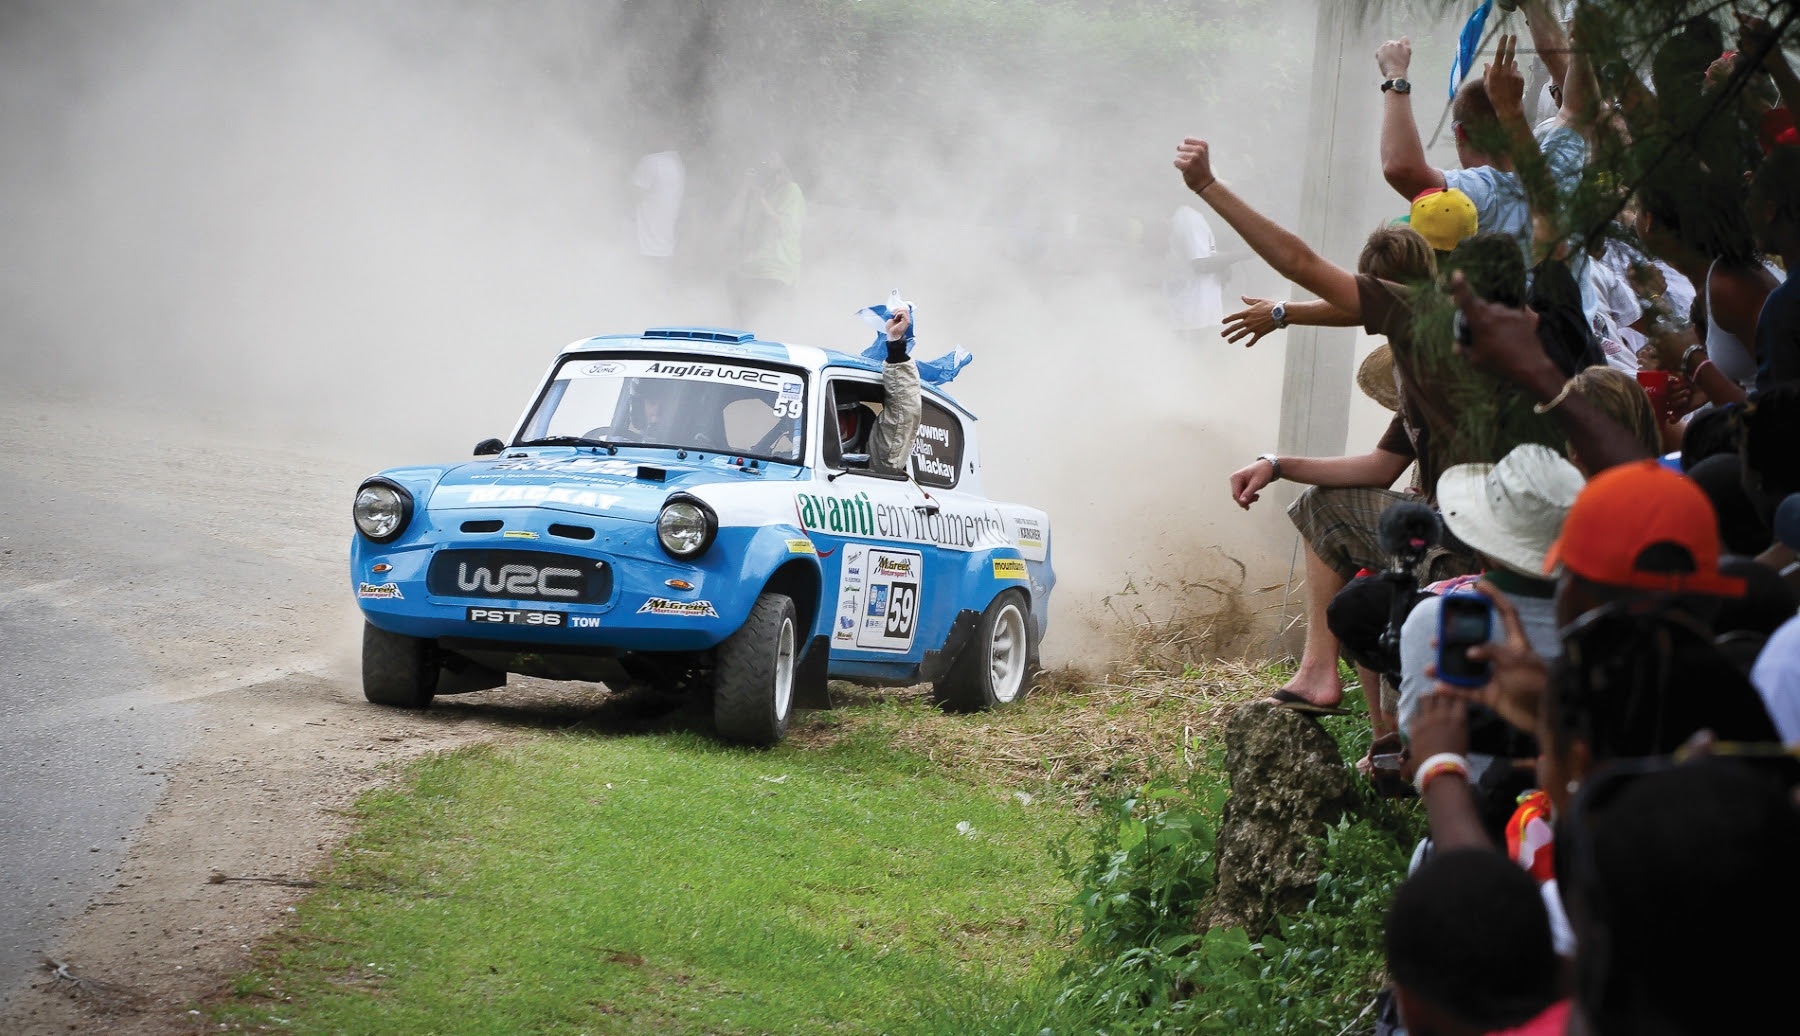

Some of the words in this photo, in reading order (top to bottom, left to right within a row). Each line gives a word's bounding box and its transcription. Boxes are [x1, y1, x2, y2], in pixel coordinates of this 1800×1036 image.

[588, 364, 616, 374] Ford
[645, 362, 714, 377] Anglia
[717, 368, 781, 386] WRC
[773, 399, 803, 419] 59
[915, 438, 933, 456] Alan
[916, 424, 949, 448] owney
[917, 454, 954, 483] Mackay
[798, 492, 874, 536] avanti
[876, 495, 1014, 548] environmental
[458, 562, 582, 596] WRC
[881, 568, 908, 578] Motorsport
[471, 609, 521, 623] PST
[526, 611, 561, 626] 36
[888, 587, 914, 633] 59
[571, 617, 600, 629] TOW
